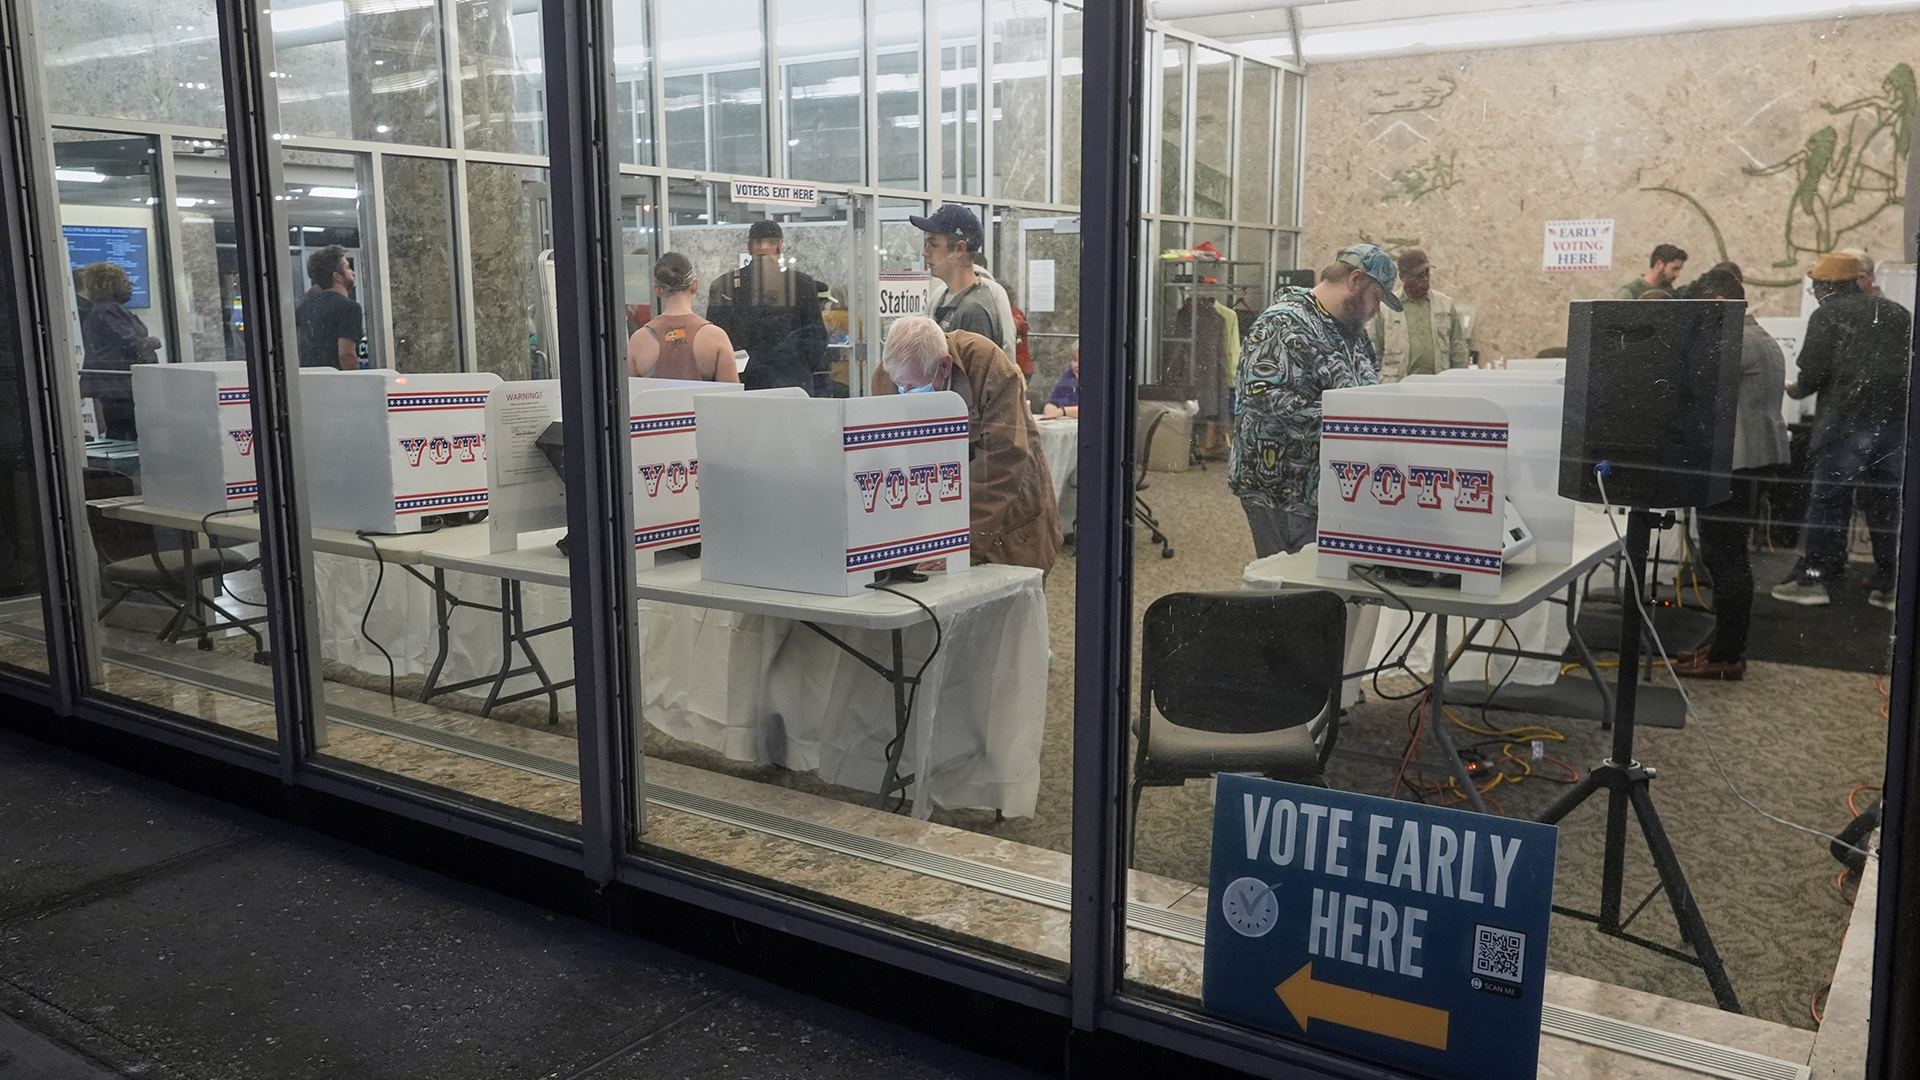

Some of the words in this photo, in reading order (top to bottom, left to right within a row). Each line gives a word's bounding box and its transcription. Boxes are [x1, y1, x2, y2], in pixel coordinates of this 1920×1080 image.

[735, 184, 770, 197] VOTERS
[772, 187, 790, 199] EXIT
[793, 188, 814, 200] HERE
[1553, 241, 1603, 251] VOTING
[1560, 228, 1598, 238] EARLY
[1558, 253, 1597, 264] HERE
[879, 289, 920, 314] Station
[922, 288, 928, 312] 3
[505, 390, 543, 401] WARNING!
[398, 432, 487, 468] VOT
[637, 458, 698, 498] VO
[853, 460, 963, 514] VOTE
[1329, 459, 1494, 514] VOTE
[1243, 793, 1354, 878] VOTE
[1364, 813, 1523, 909] EARLY
[1308, 887, 1429, 979] HERE
[1484, 983, 1503, 992] SCAN
